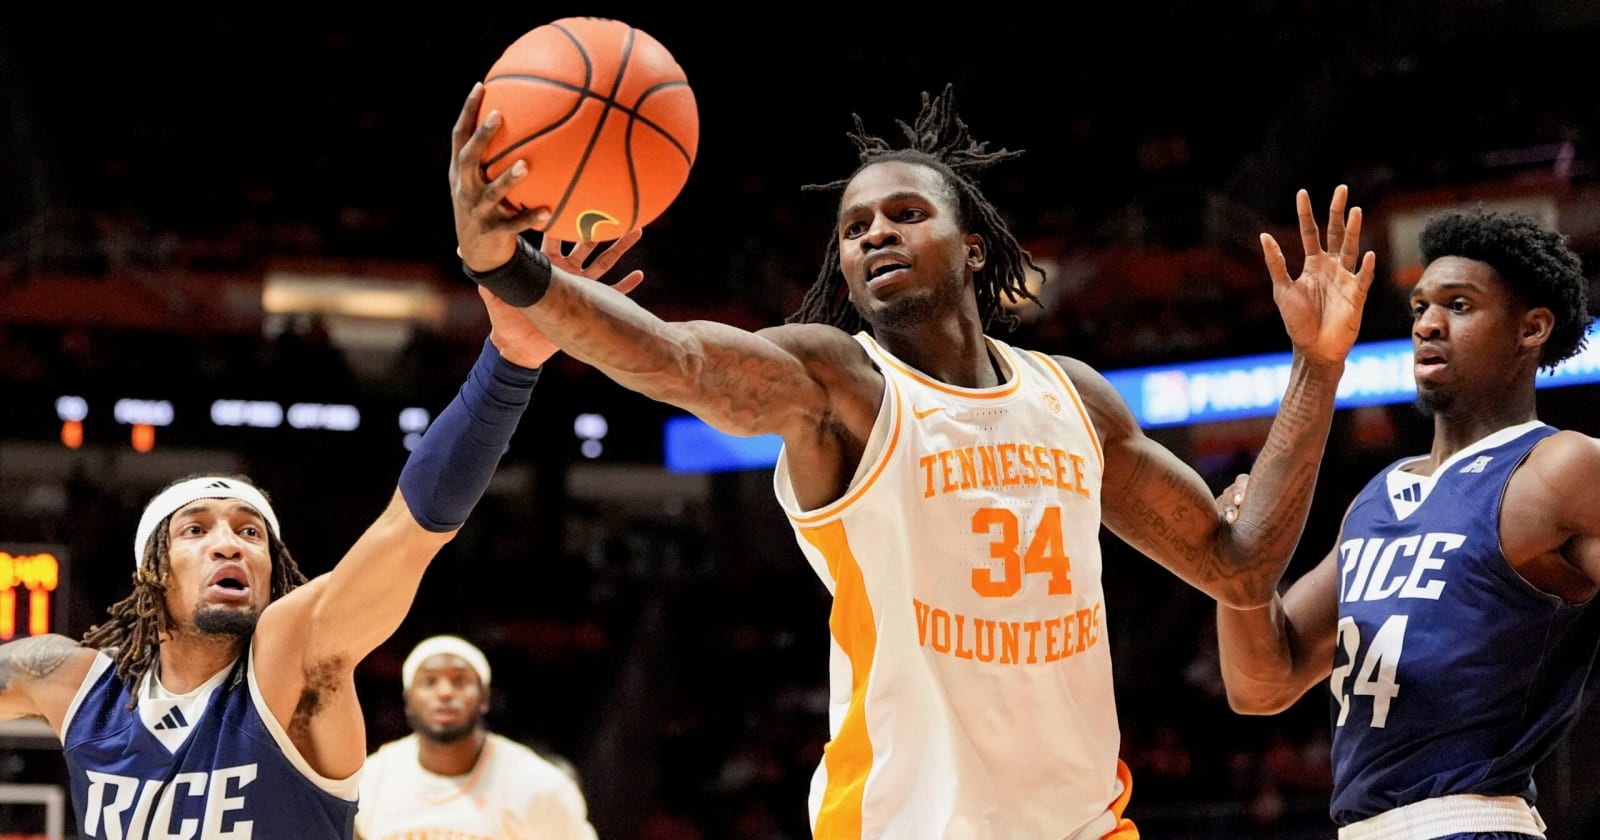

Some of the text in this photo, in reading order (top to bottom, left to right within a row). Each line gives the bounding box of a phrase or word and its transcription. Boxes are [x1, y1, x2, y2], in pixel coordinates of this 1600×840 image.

[919, 443, 1091, 499] TENNESSEE
[971, 507, 1072, 598] 34
[913, 598, 1102, 665] VOLUNTEERS
[1330, 614, 1409, 728] 24
[84, 762, 258, 840] RICE
